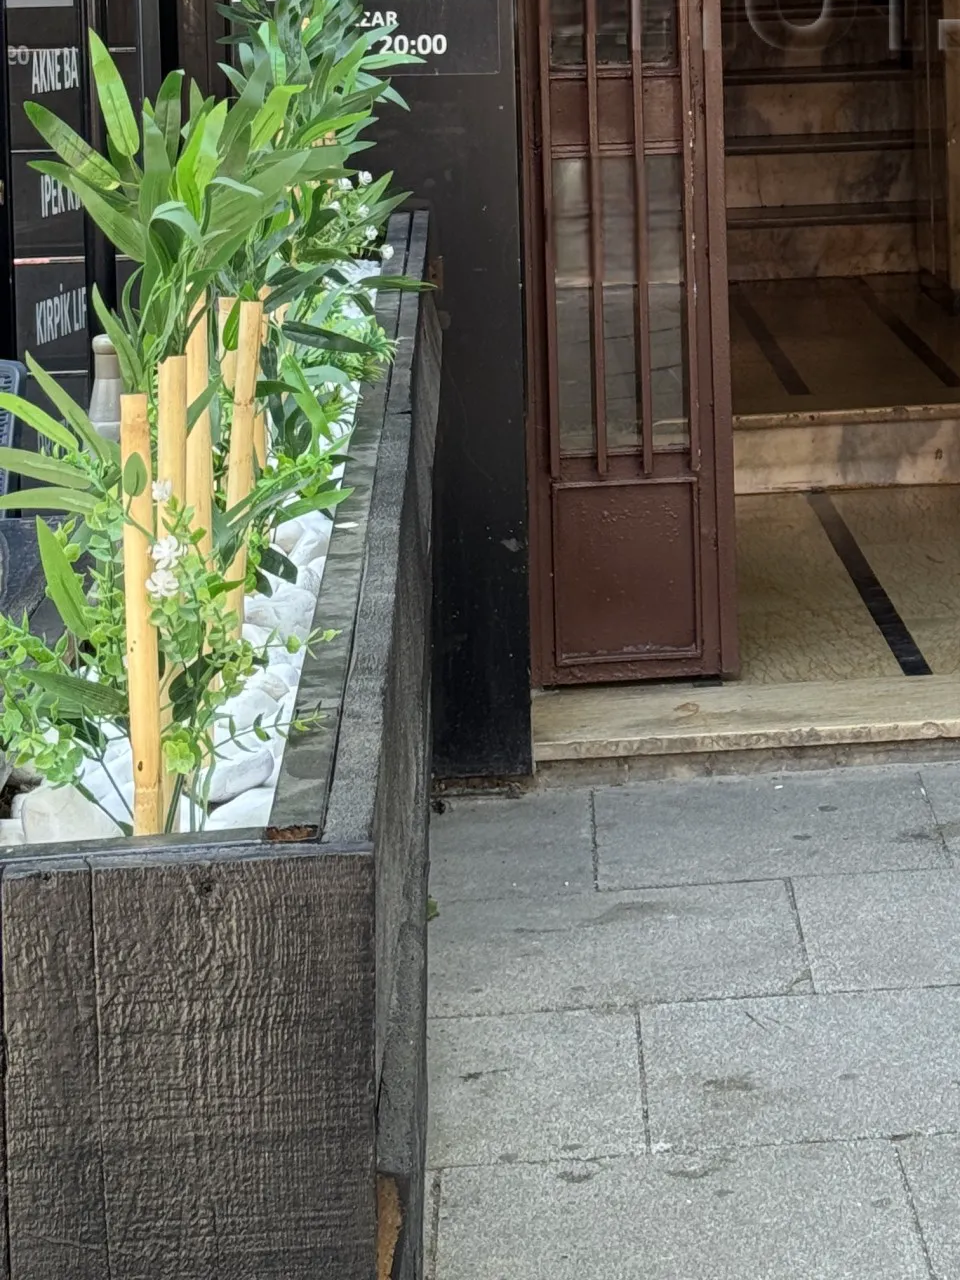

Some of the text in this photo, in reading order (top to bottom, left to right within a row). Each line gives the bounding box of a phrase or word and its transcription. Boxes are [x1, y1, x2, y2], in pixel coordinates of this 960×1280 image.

[380, 34, 447, 56] 20:00
[32, 49, 62, 94] AKNE
[36, 283, 72, 346] KIRPİK
